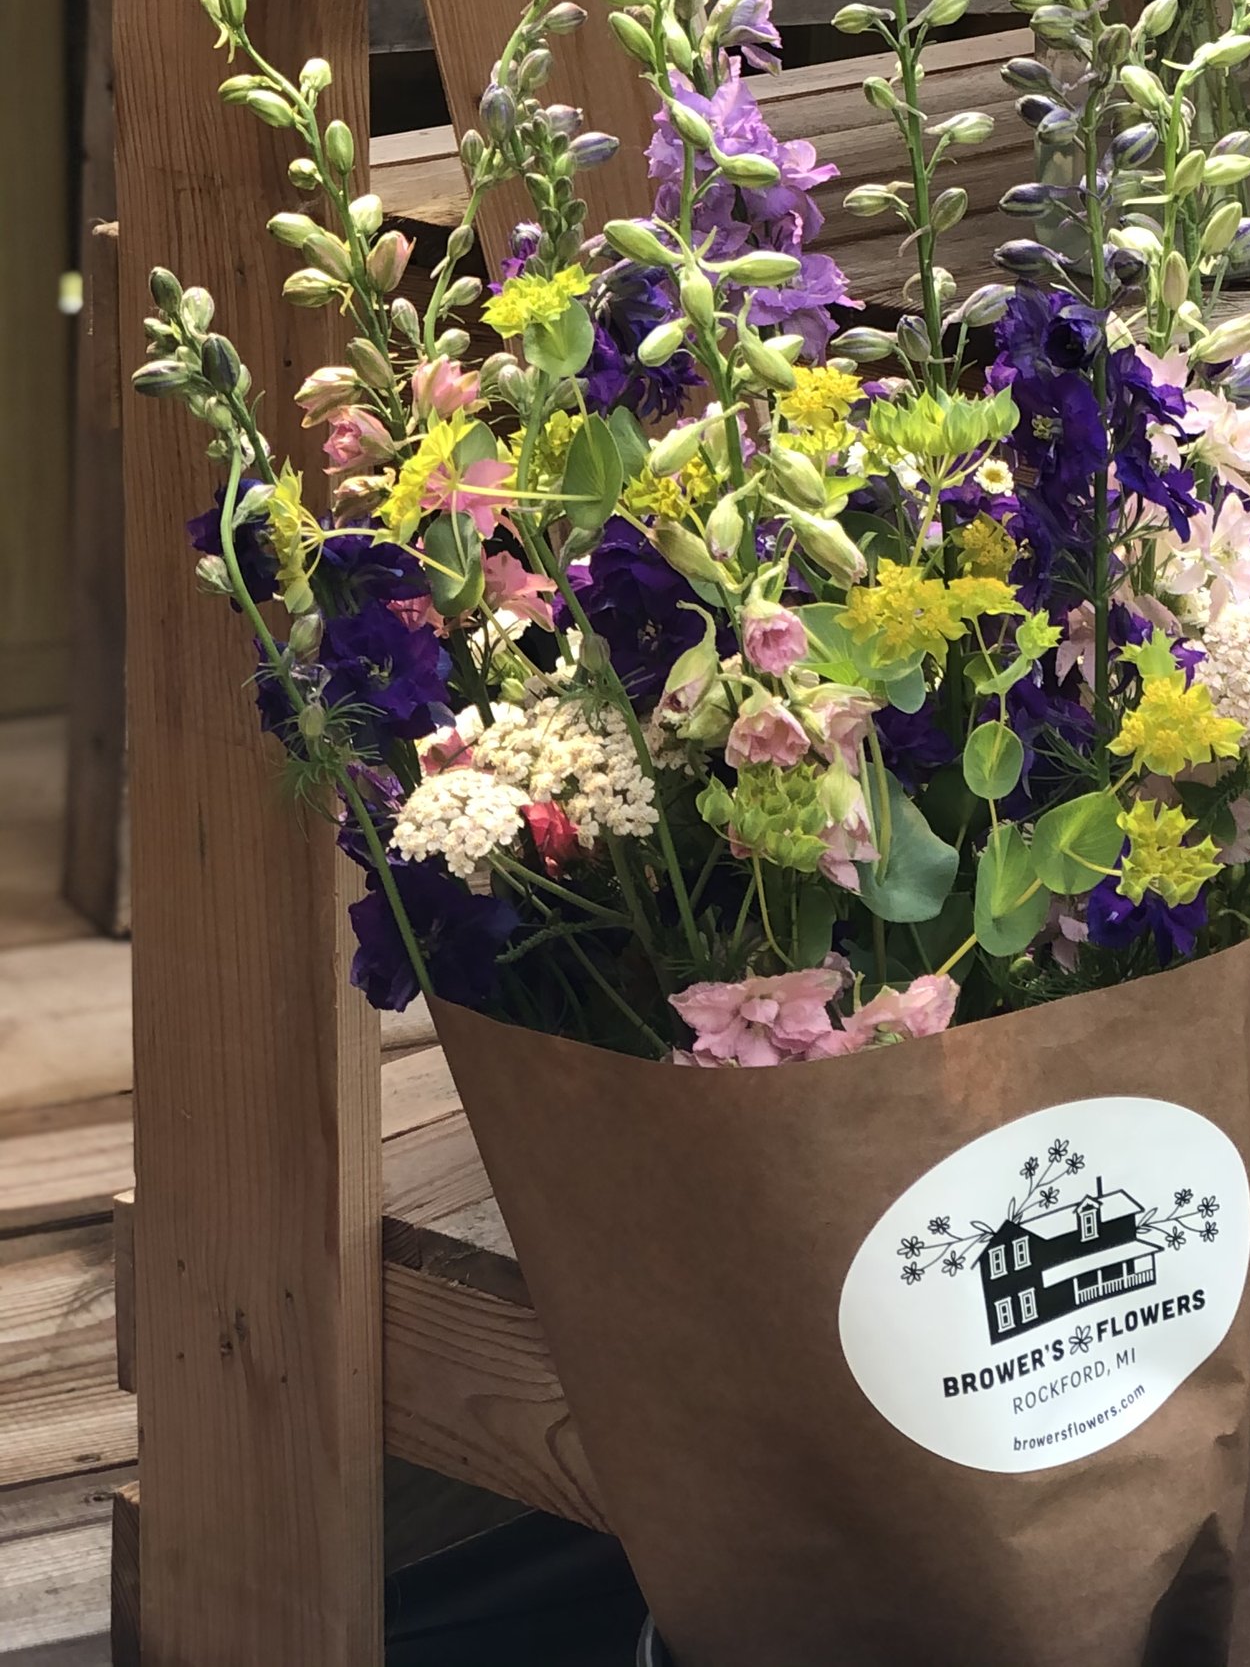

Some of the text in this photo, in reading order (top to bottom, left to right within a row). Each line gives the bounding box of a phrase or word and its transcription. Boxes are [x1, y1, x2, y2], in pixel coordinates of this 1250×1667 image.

[942, 1288, 1206, 1398] BROWER'S FLOWERS
[1012, 1347, 1137, 1415] ROCKFORD, MI
[1013, 1384, 1146, 1452] browersflowers.com
